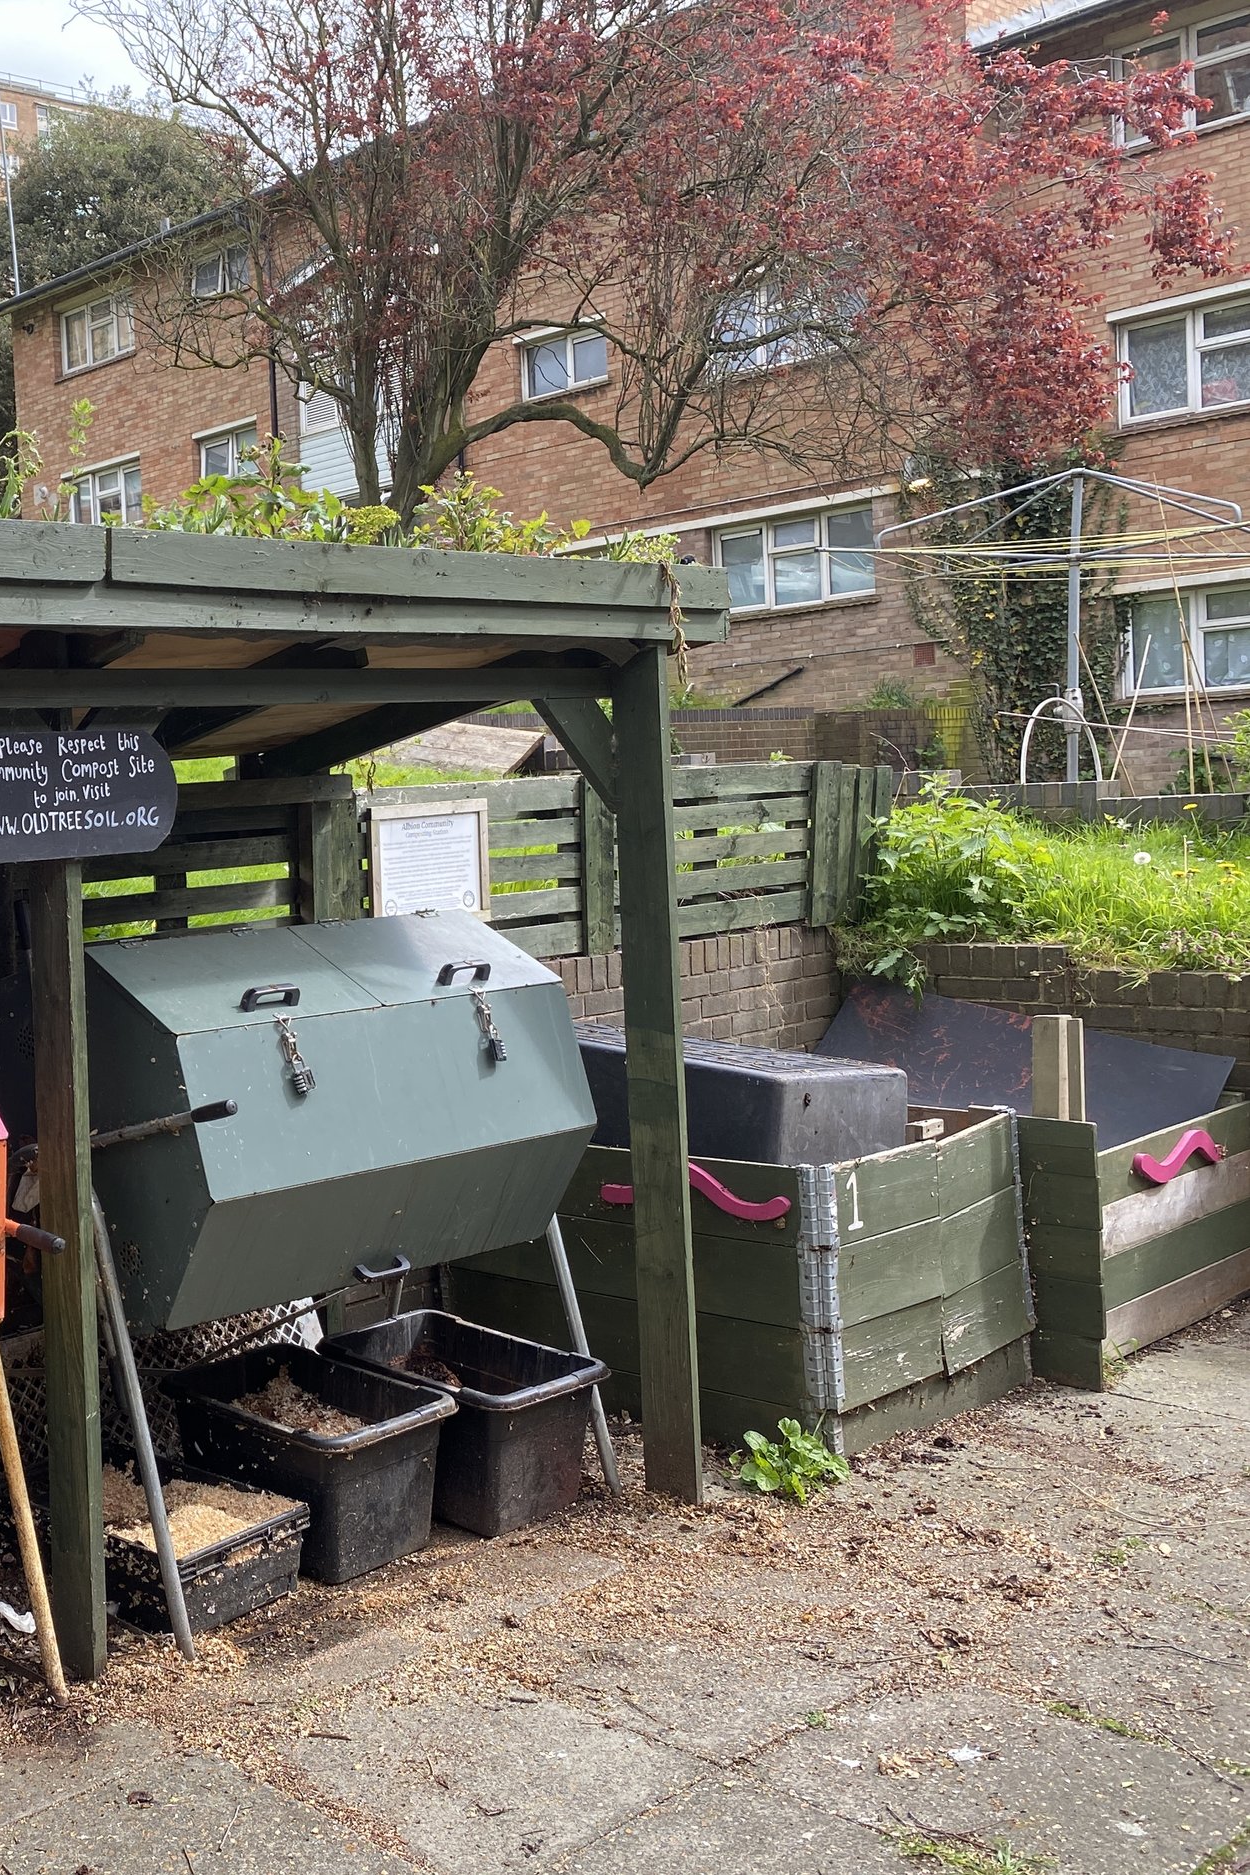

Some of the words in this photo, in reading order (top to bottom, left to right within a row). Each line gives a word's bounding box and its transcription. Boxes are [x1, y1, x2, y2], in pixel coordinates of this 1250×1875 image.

[58, 735, 106, 756] Respect
[118, 733, 139, 751] this
[62, 759, 119, 782] Compost
[129, 755, 154, 777] Site
[34, 791, 46, 808] to
[847, 1172, 864, 1231] 1
